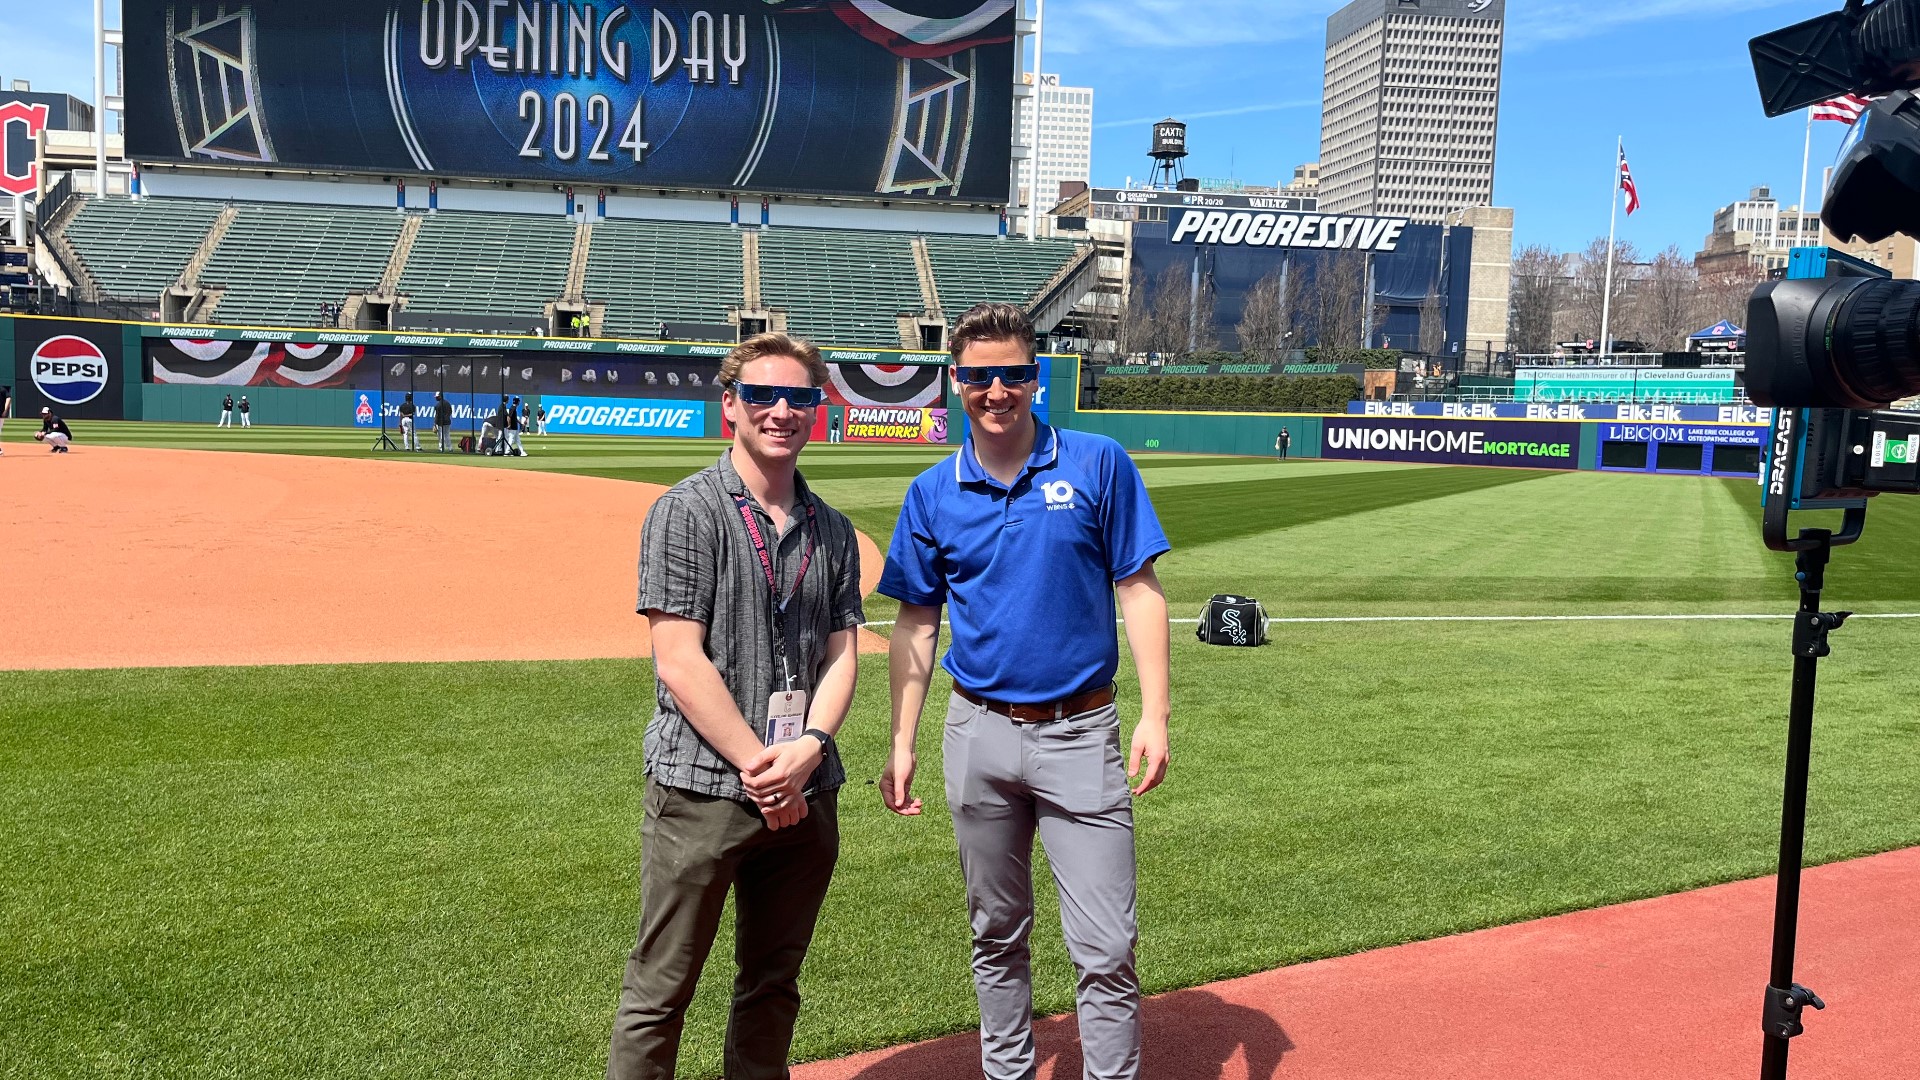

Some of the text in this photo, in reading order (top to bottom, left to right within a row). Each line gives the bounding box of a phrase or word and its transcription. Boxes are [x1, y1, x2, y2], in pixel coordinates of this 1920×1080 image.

[420, 0, 747, 84] OPENING DAY
[518, 90, 649, 162] 2024
[0, 100, 50, 196] C
[1191, 195, 1224, 206] PR 20/20
[1249, 198, 1290, 209] VAULTZ
[1171, 210, 1407, 251] PROGRESSIVE
[162, 327, 216, 338] PROGRESSIVE
[240, 330, 294, 340] PROGRESSIVE
[317, 333, 370, 343] PROGRESSIVE
[394, 335, 446, 345] PROGRESSIVE
[469, 338, 521, 348] PROGRESSIVE
[543, 340, 594, 350] PROGRESSIVE
[617, 343, 666, 353] PROGRESSIVE
[689, 346, 734, 355] PROGRESSIV
[830, 351, 878, 361] PROGRESSIVE
[900, 353, 947, 363] PROGRESSIVE
[36, 361, 103, 378] PEPSI
[1105, 366, 1150, 375] PROGRESSIVE
[1160, 365, 1209, 374] PROGRESSIVE
[1219, 364, 1272, 374] PROGRESSIVE
[1283, 364, 1340, 374] PROGRESSIVE
[1537, 371, 1564, 379] Official
[1566, 371, 1590, 379] Health
[1591, 371, 1618, 379] Insurer
[1619, 371, 1628, 379] of
[1644, 371, 1685, 379] Cleveland
[1686, 371, 1731, 379] Guardians
[546, 405, 695, 429] PROGRESSIVE
[849, 408, 921, 424] PHANTOM
[846, 424, 920, 439] FIREWORKS
[1704, 428, 1718, 436] ERIE
[1718, 429, 1744, 437] COLLEGE
[1144, 439, 1160, 449] 400
[1483, 441, 1570, 458] MORTGAGE
[1769, 407, 1793, 495] DRACAST
[1040, 480, 1074, 504] 10
[1046, 503, 1068, 511] WBNS
